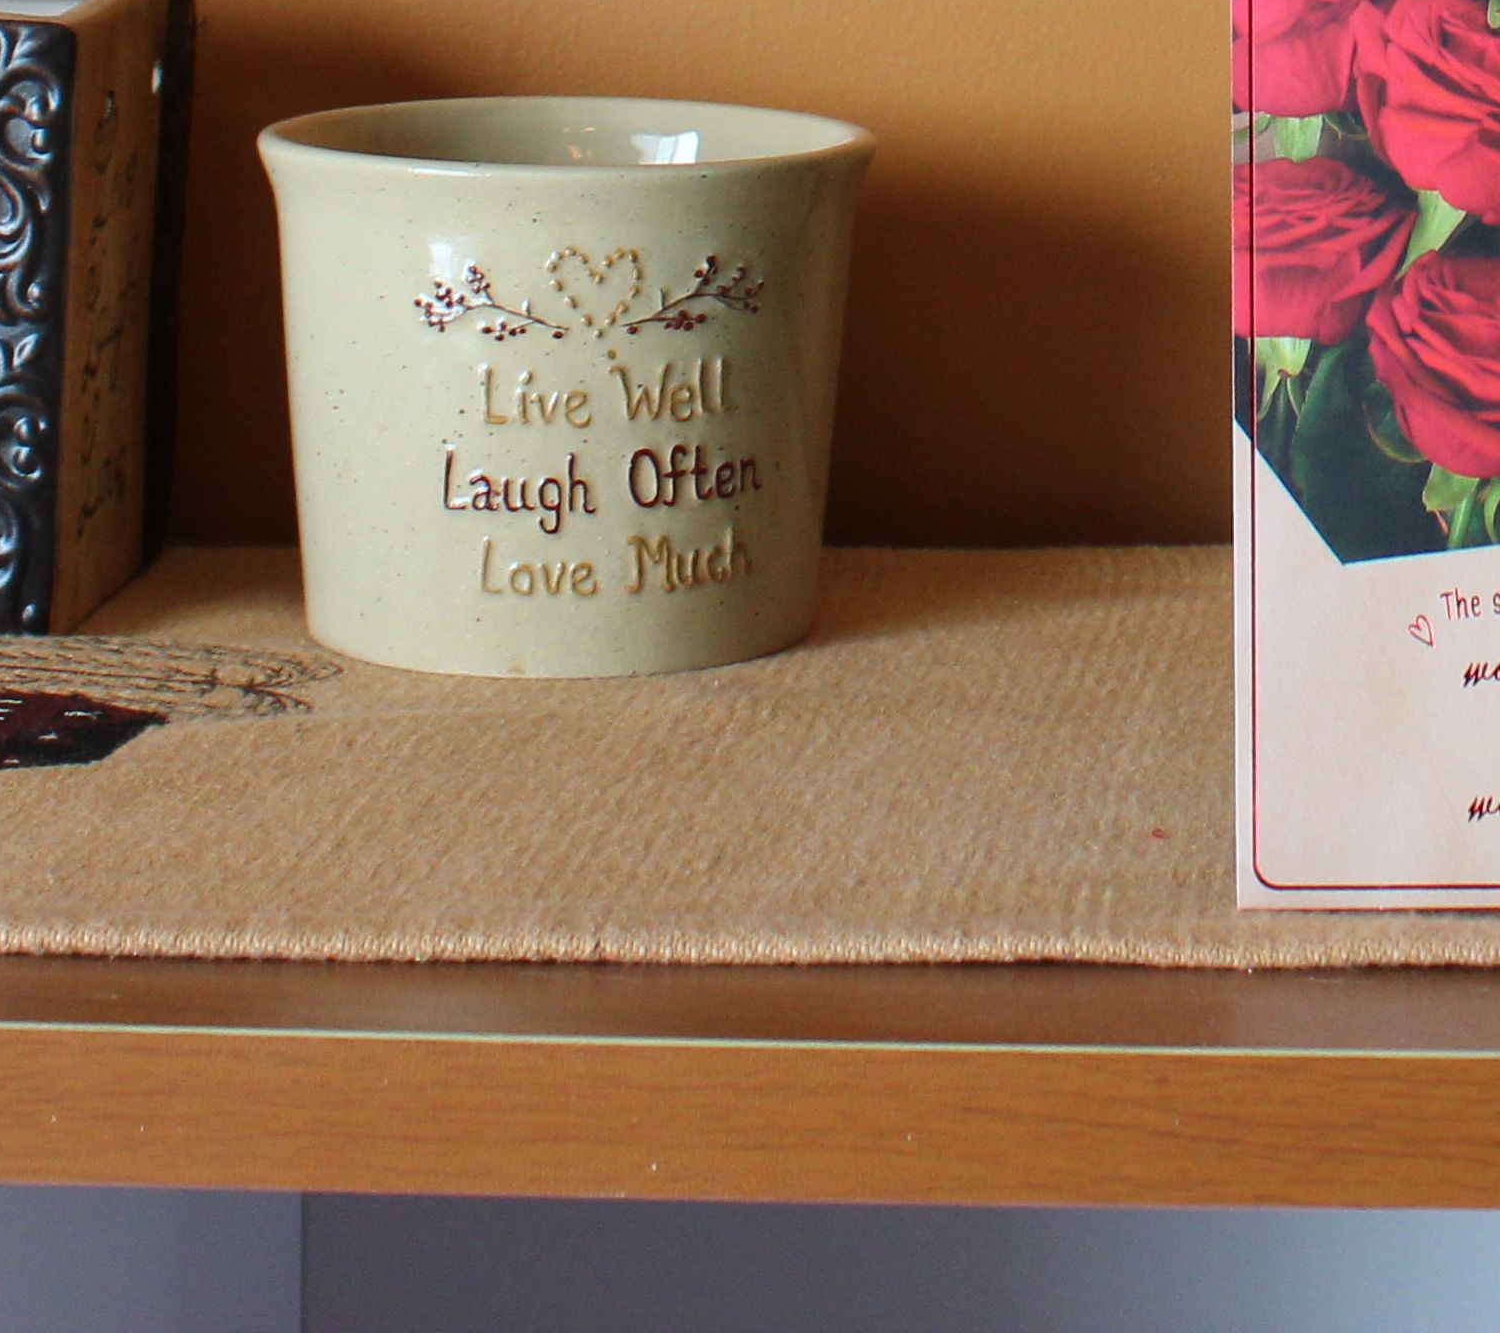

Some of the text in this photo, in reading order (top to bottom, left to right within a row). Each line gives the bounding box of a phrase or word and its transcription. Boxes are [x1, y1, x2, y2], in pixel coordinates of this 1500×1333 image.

[478, 356, 738, 429] Live Well
[443, 444, 762, 534] Laugh Often
[480, 522, 752, 597] Love Much
[1440, 588, 1482, 620] The
